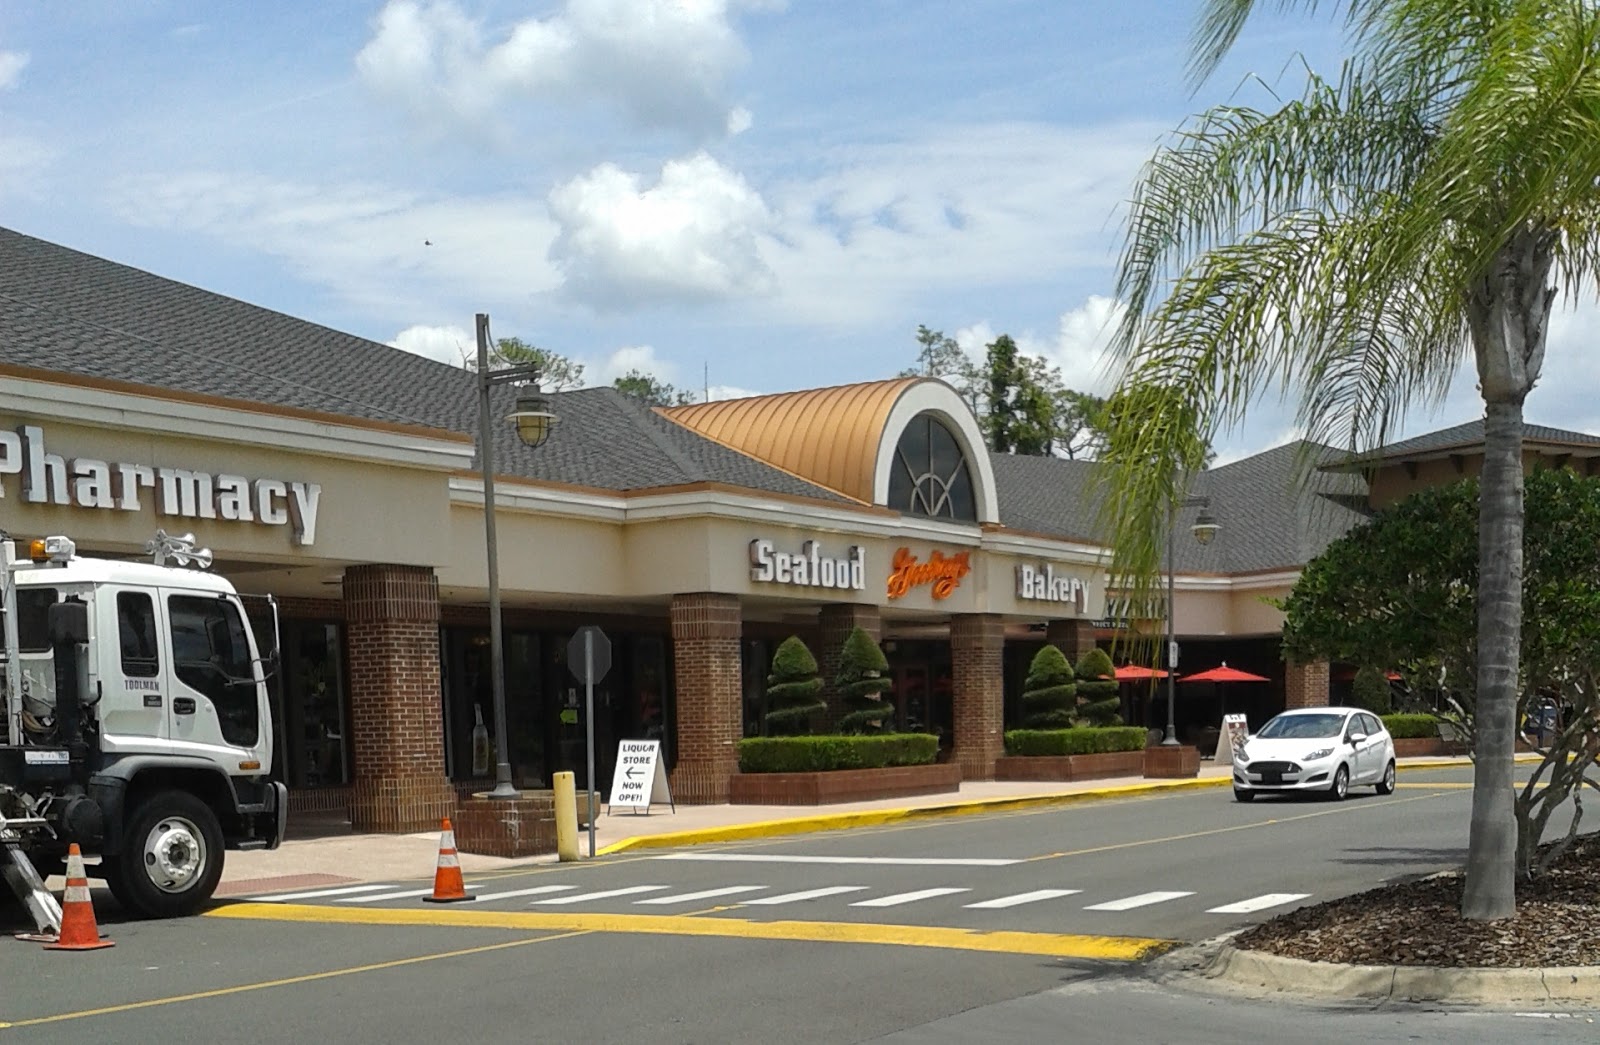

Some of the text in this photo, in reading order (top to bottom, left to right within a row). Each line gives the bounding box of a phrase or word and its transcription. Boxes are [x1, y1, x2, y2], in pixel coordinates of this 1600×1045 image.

[750, 539, 865, 590] Seafood
[1015, 563, 1089, 614] Bakery
[124, 679, 160, 692] TOOLMAN
[622, 744, 655, 752] LIQUOR
[623, 756, 650, 764] STORE
